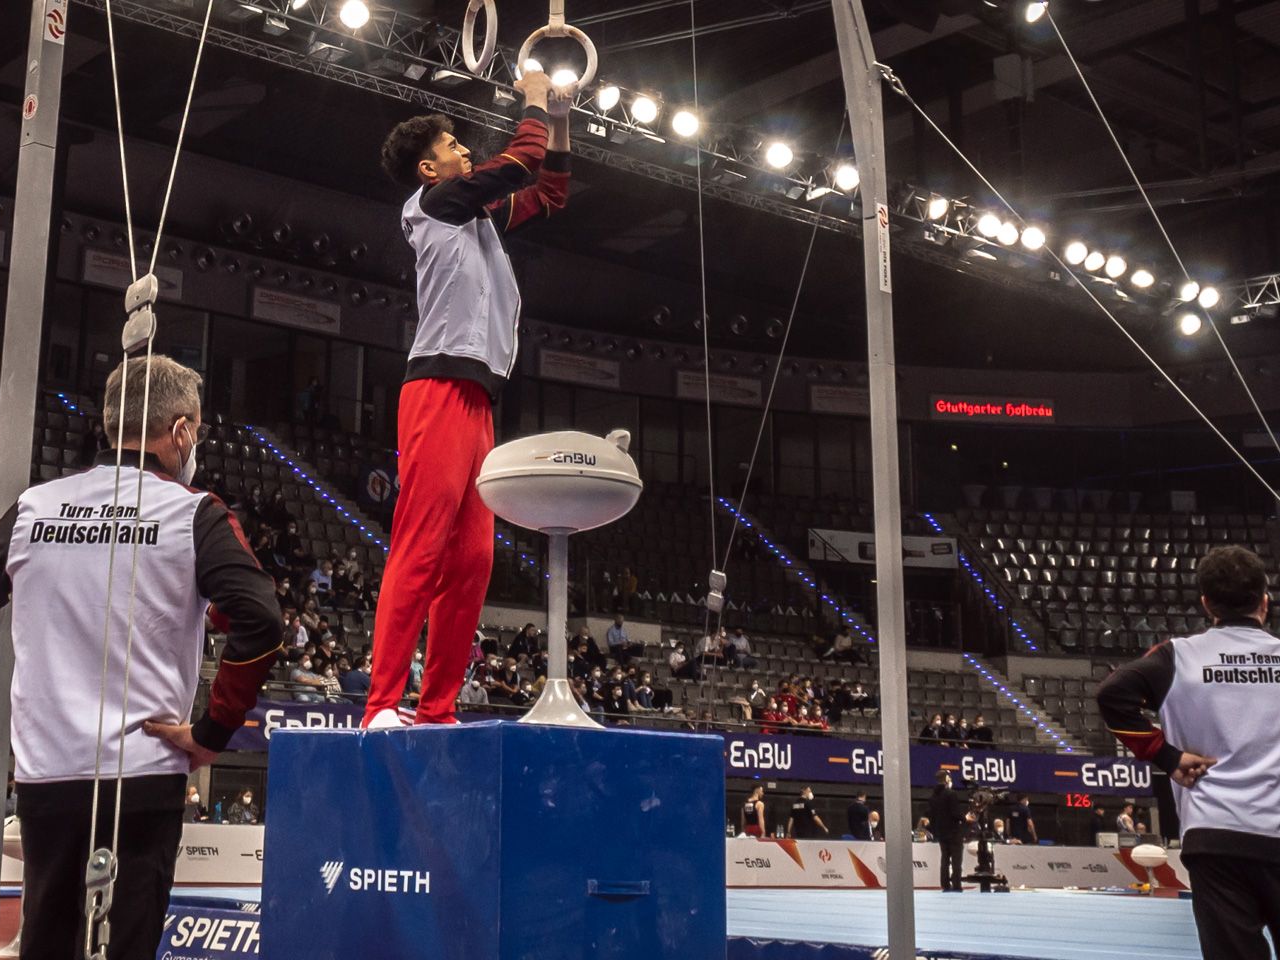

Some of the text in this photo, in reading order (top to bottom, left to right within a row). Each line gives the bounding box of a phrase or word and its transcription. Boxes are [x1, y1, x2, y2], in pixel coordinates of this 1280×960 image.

[936, 400, 1003, 416] Stuttgarter
[553, 451, 597, 466] EnBW
[59, 503, 140, 519] Turn-Team
[30, 521, 160, 546] Deutschland
[729, 740, 792, 771] EnBW
[961, 756, 1017, 783] EnBW
[1081, 762, 1151, 788] EnBW
[1065, 793, 1092, 808] 126
[185, 846, 219, 856] SPIETH
[348, 867, 431, 894] SPIETH
[169, 915, 261, 954] SPIETH
